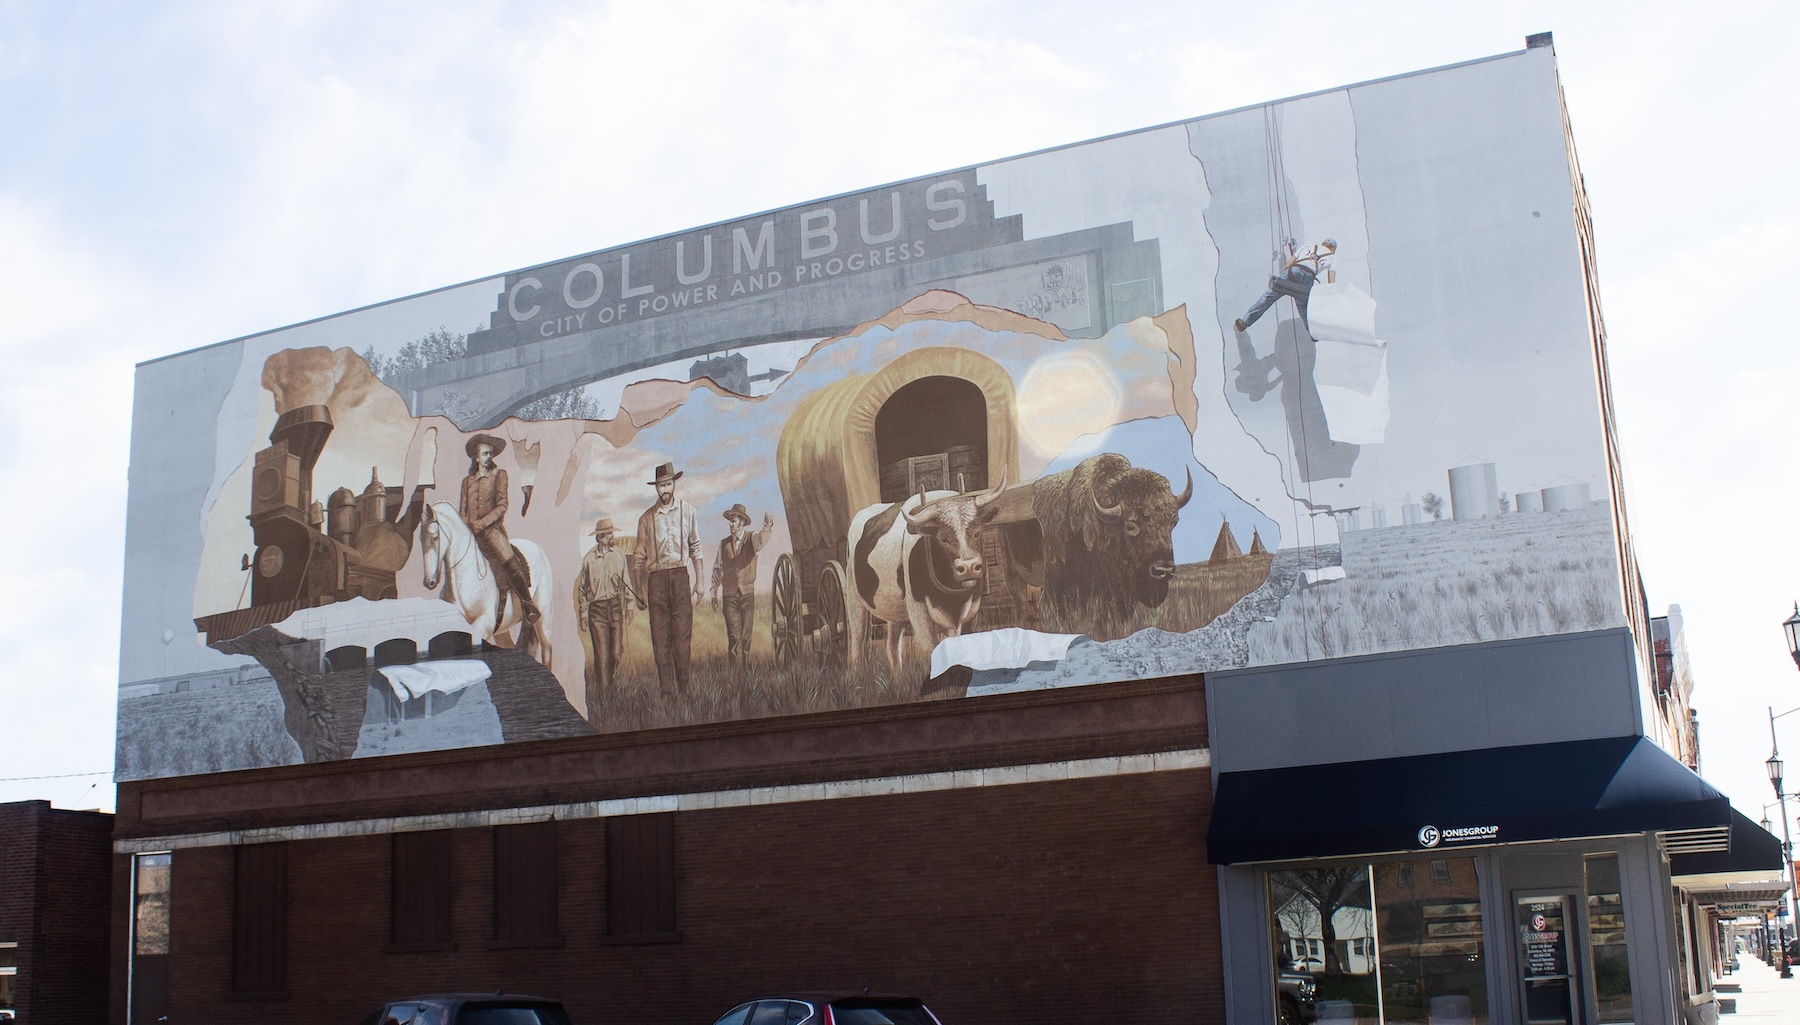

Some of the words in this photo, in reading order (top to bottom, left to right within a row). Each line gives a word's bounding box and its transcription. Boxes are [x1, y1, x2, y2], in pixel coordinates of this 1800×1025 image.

[508, 180, 966, 322] COLUMBUS
[540, 313, 586, 337] CITY
[599, 303, 627, 323] OF
[639, 285, 718, 315] POWER
[731, 271, 781, 296] AND
[796, 240, 925, 282] PROGRESS
[1442, 826, 1499, 838] JONESGROUP
[1531, 903, 1545, 911] 2524
